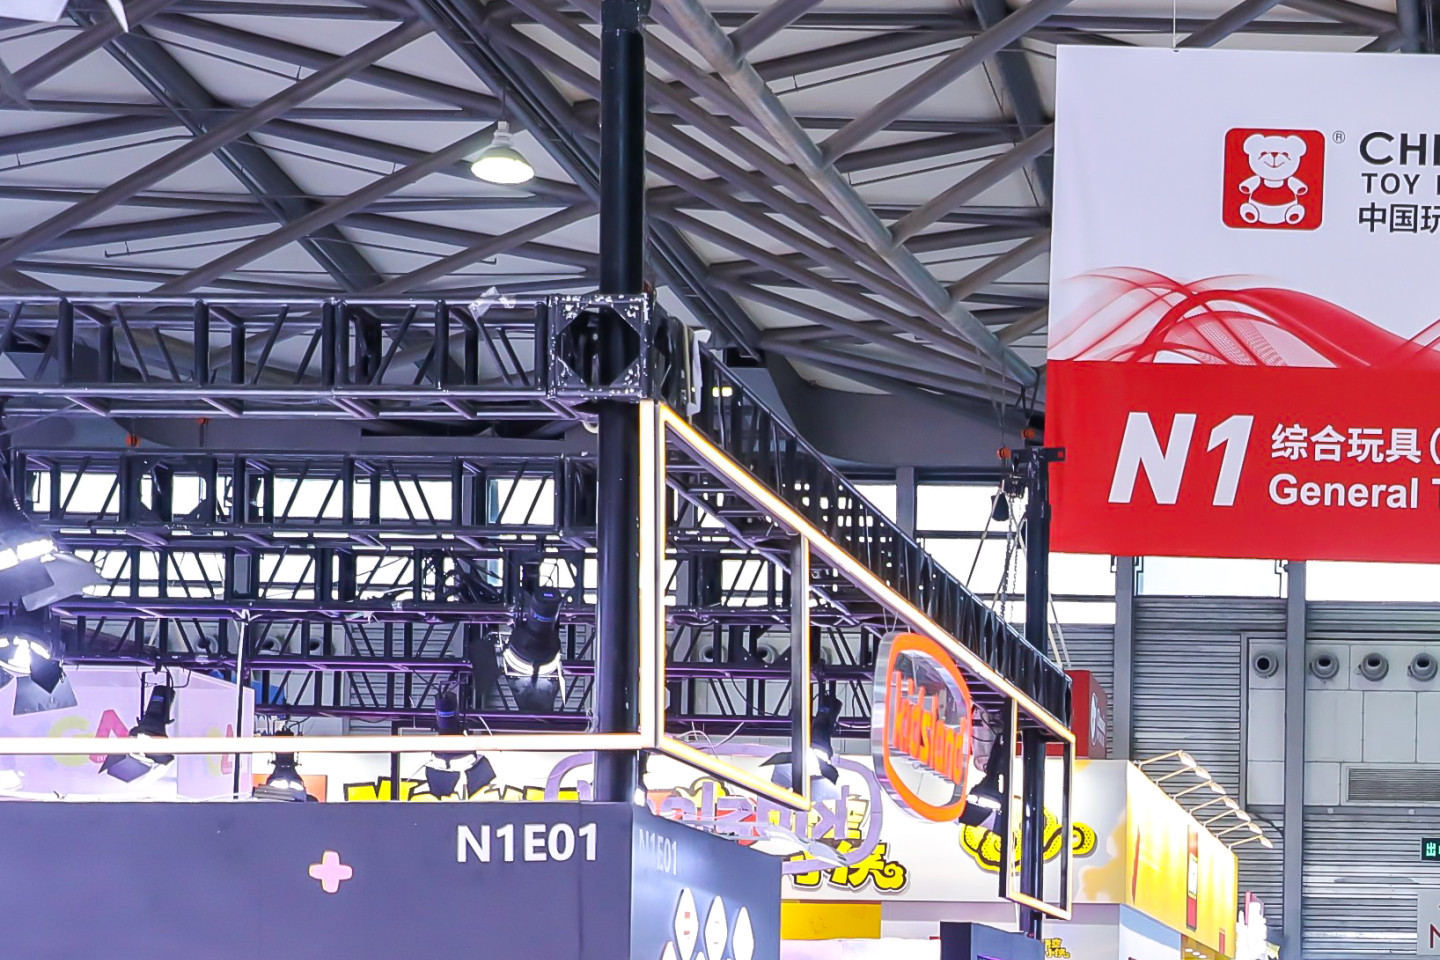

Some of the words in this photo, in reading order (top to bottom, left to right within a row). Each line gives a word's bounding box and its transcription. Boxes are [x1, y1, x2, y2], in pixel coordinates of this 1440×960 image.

[1361, 172, 1420, 195] TOY
[1107, 411, 1254, 506] N1
[1268, 473, 1418, 509] General
[457, 822, 598, 863] N1E01
[639, 828, 678, 877] N1E01
